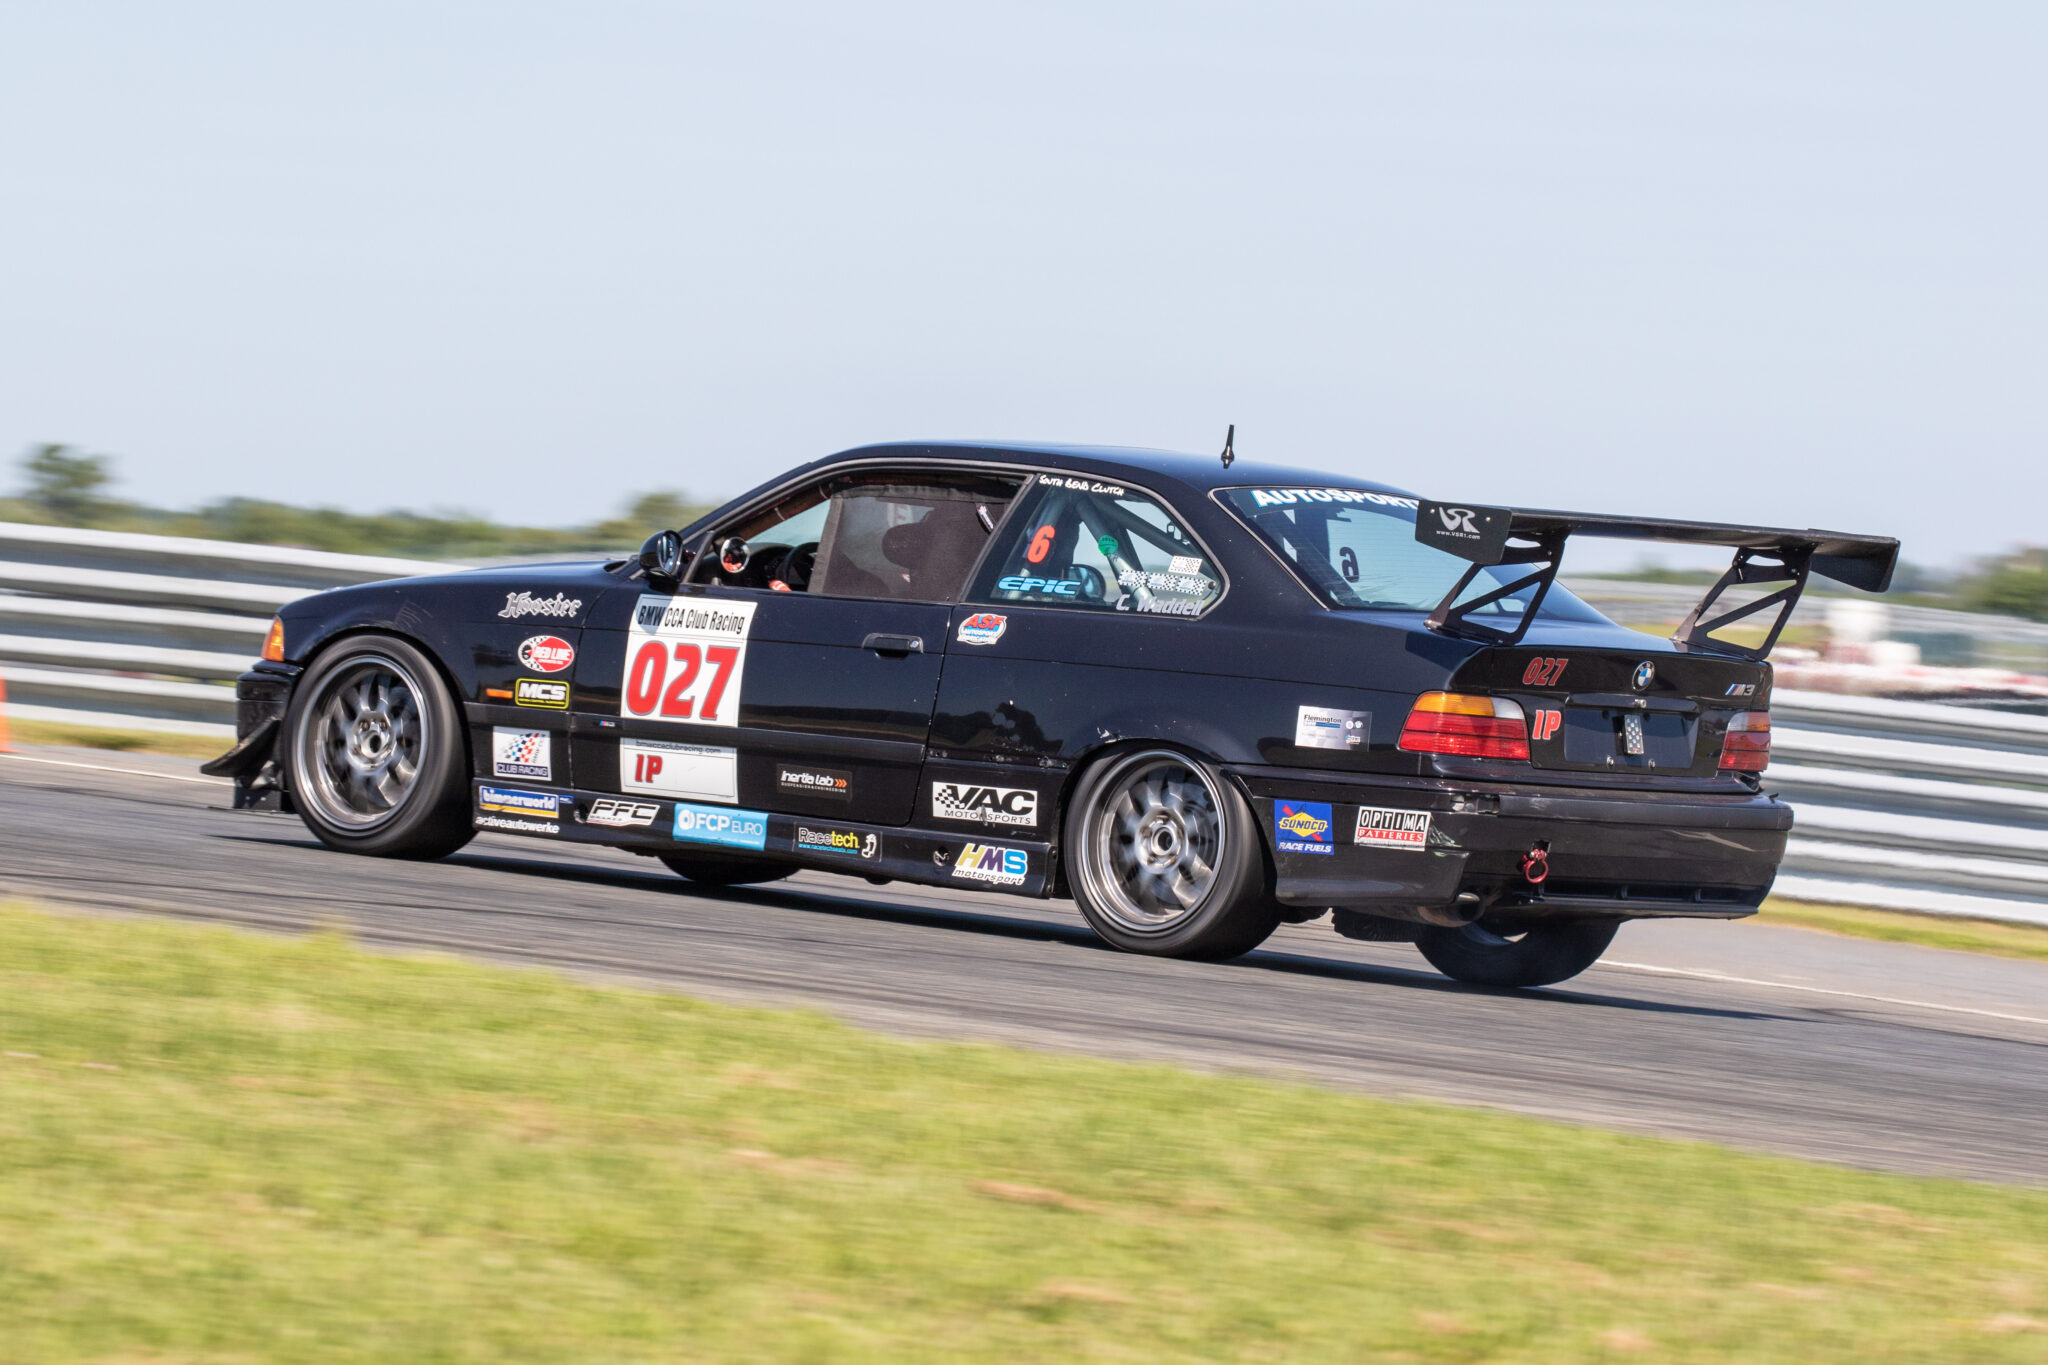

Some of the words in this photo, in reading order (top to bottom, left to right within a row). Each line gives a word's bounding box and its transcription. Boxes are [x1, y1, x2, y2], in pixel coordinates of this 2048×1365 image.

[1065, 478, 1089, 491] BEND
[1027, 525, 1056, 563] 6
[1436, 530, 1481, 540] www.VSR1.com
[998, 576, 1081, 595] EPIC
[498, 591, 582, 618] Hoosier
[1116, 593, 1131, 611] C.
[1137, 595, 1205, 616] Waddell
[638, 605, 667, 626] BMW
[664, 608, 686, 628] CCA
[685, 608, 709, 630] Club
[709, 611, 746, 635] Racing
[964, 615, 1006, 630] ASF
[626, 640, 741, 721] 027
[1522, 657, 1569, 686] 027
[518, 682, 567, 701] MCS
[1304, 714, 1342, 724] Flemington
[1532, 709, 1562, 740] IP
[497, 763, 518, 774] CLUB
[519, 765, 548, 777] RACING
[781, 770, 815, 784] Inertia
[815, 774, 834, 787] lab
[482, 788, 556, 810] bimmerworld
[945, 785, 1035, 815] VAC
[592, 800, 657, 820] PFC
[475, 816, 560, 833] activeautowerke
[696, 813, 731, 831] FCP
[731, 820, 764, 836] EURO
[1281, 818, 1326, 831] SUNOCO
[1361, 810, 1425, 831] OPTIMA
[798, 827, 859, 849] Racetech
[1359, 829, 1423, 842] BATTERIES
[1279, 841, 1304, 851] RACE
[1304, 843, 1332, 853] FUELS
[956, 844, 1026, 876] HMS
[953, 869, 1023, 885] motorsport
